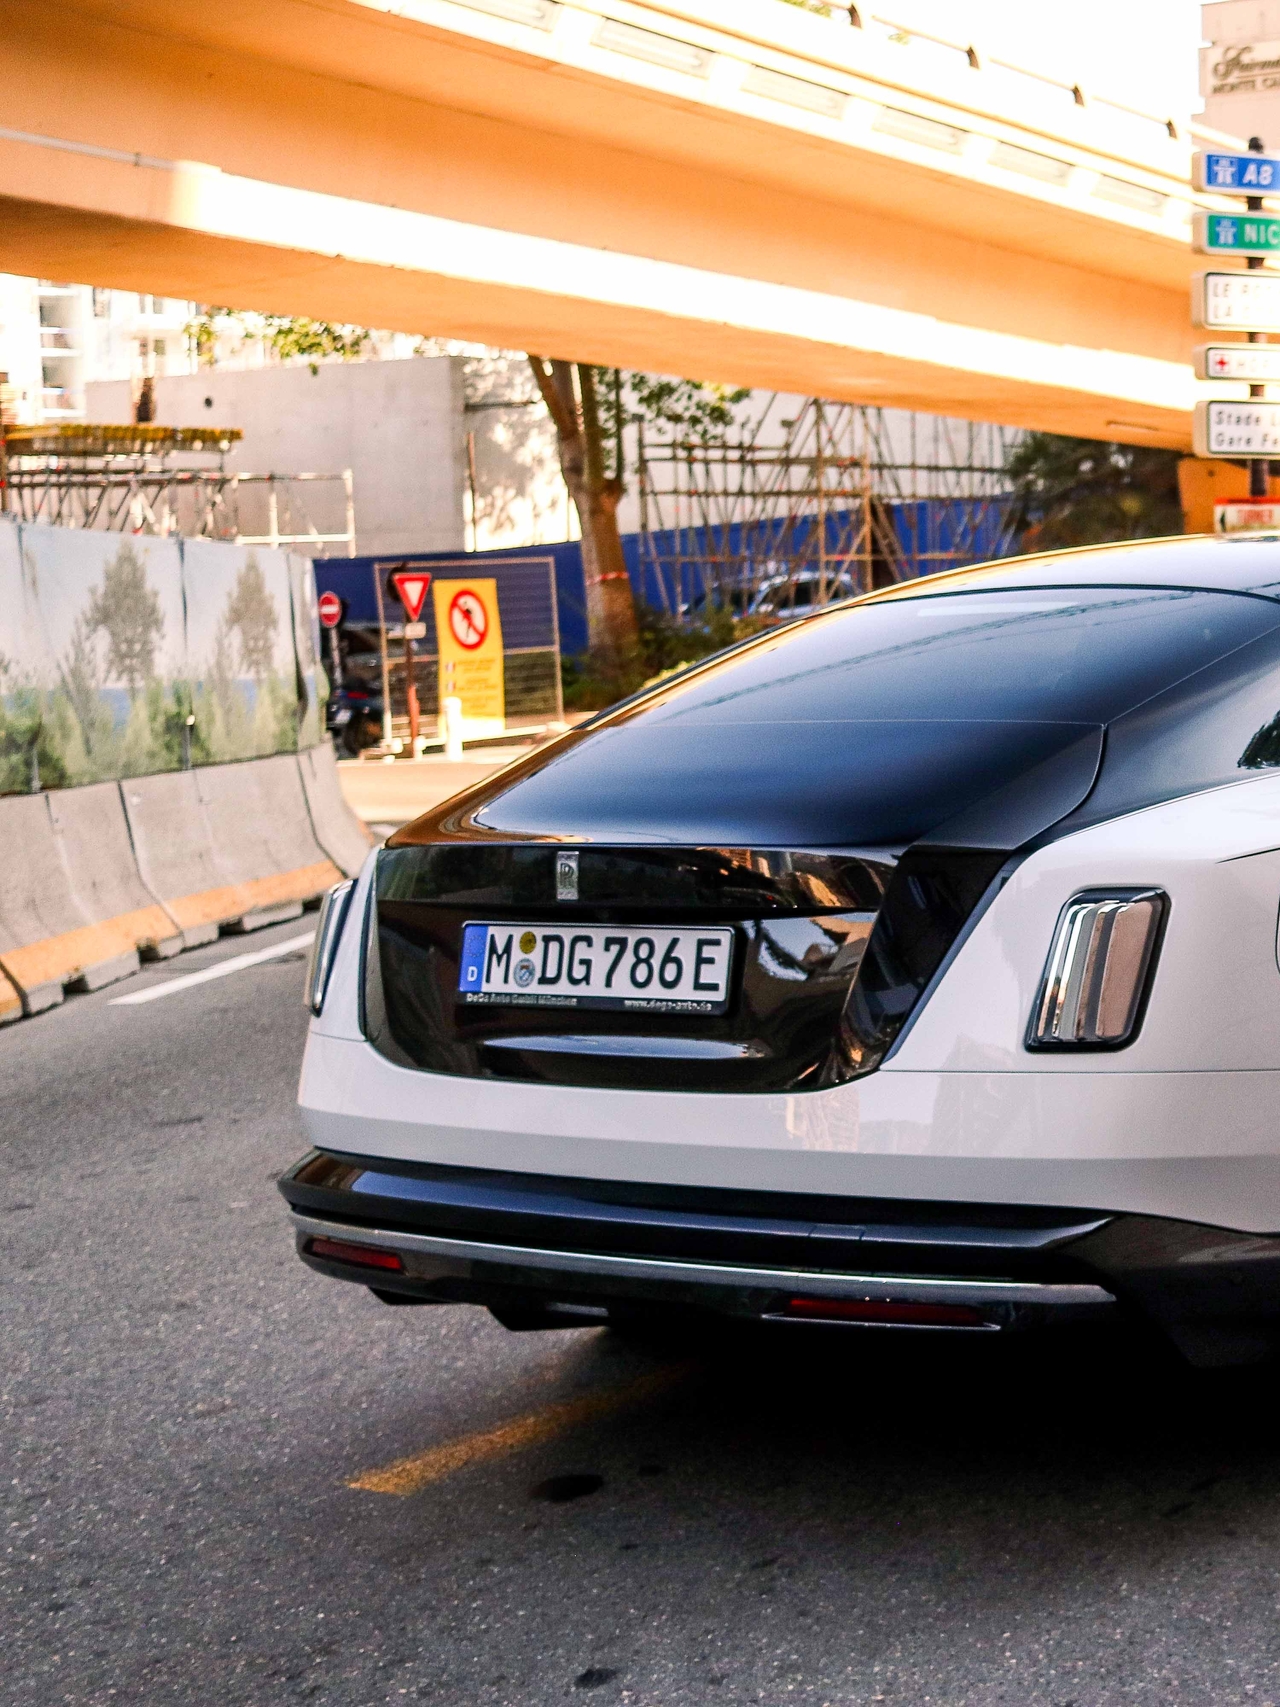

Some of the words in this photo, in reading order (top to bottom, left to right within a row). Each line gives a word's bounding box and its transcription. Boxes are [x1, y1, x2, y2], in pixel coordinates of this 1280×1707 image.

[1243, 164, 1273, 186] A8
[1214, 409, 1262, 427] Stade
[1214, 431, 1254, 448] Gare
[466, 966, 478, 982] D
